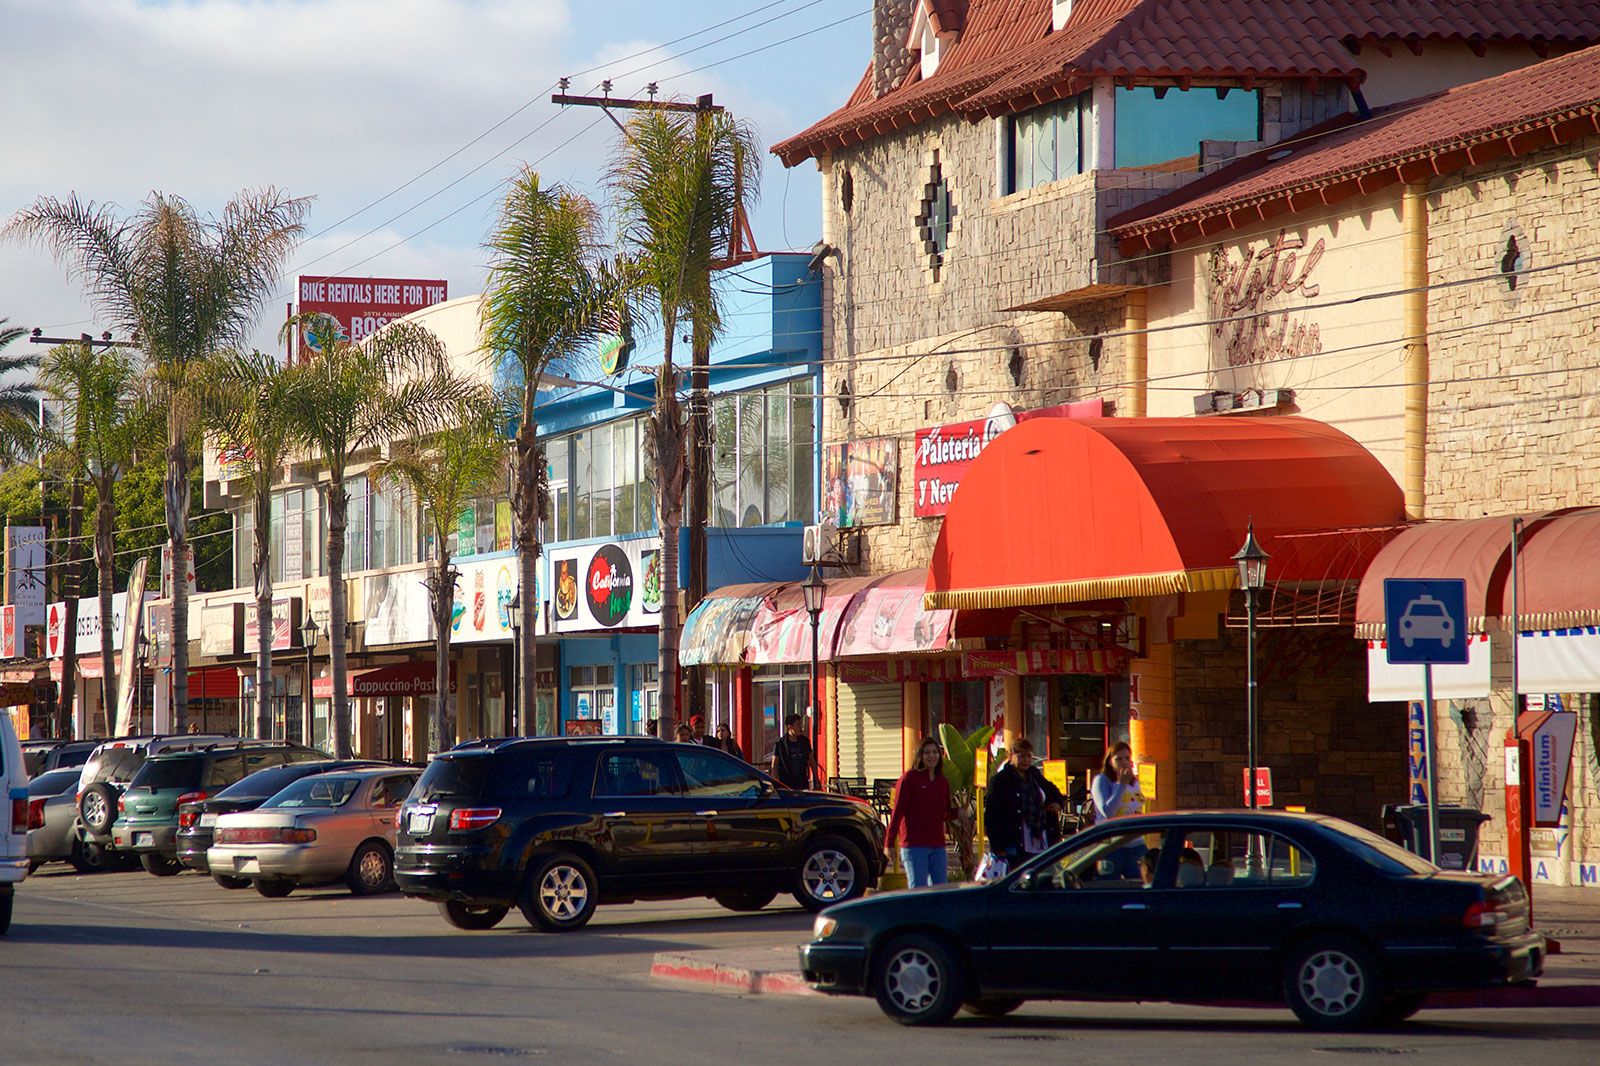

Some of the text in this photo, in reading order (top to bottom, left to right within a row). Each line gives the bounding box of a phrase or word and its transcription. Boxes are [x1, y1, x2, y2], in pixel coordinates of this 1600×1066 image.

[301, 282, 445, 305] BIKE RENTALS HERE FOR THE
[592, 564, 631, 592] California
[354, 678, 410, 694] Cappuccino
[1538, 734, 1551, 809] infinitum
